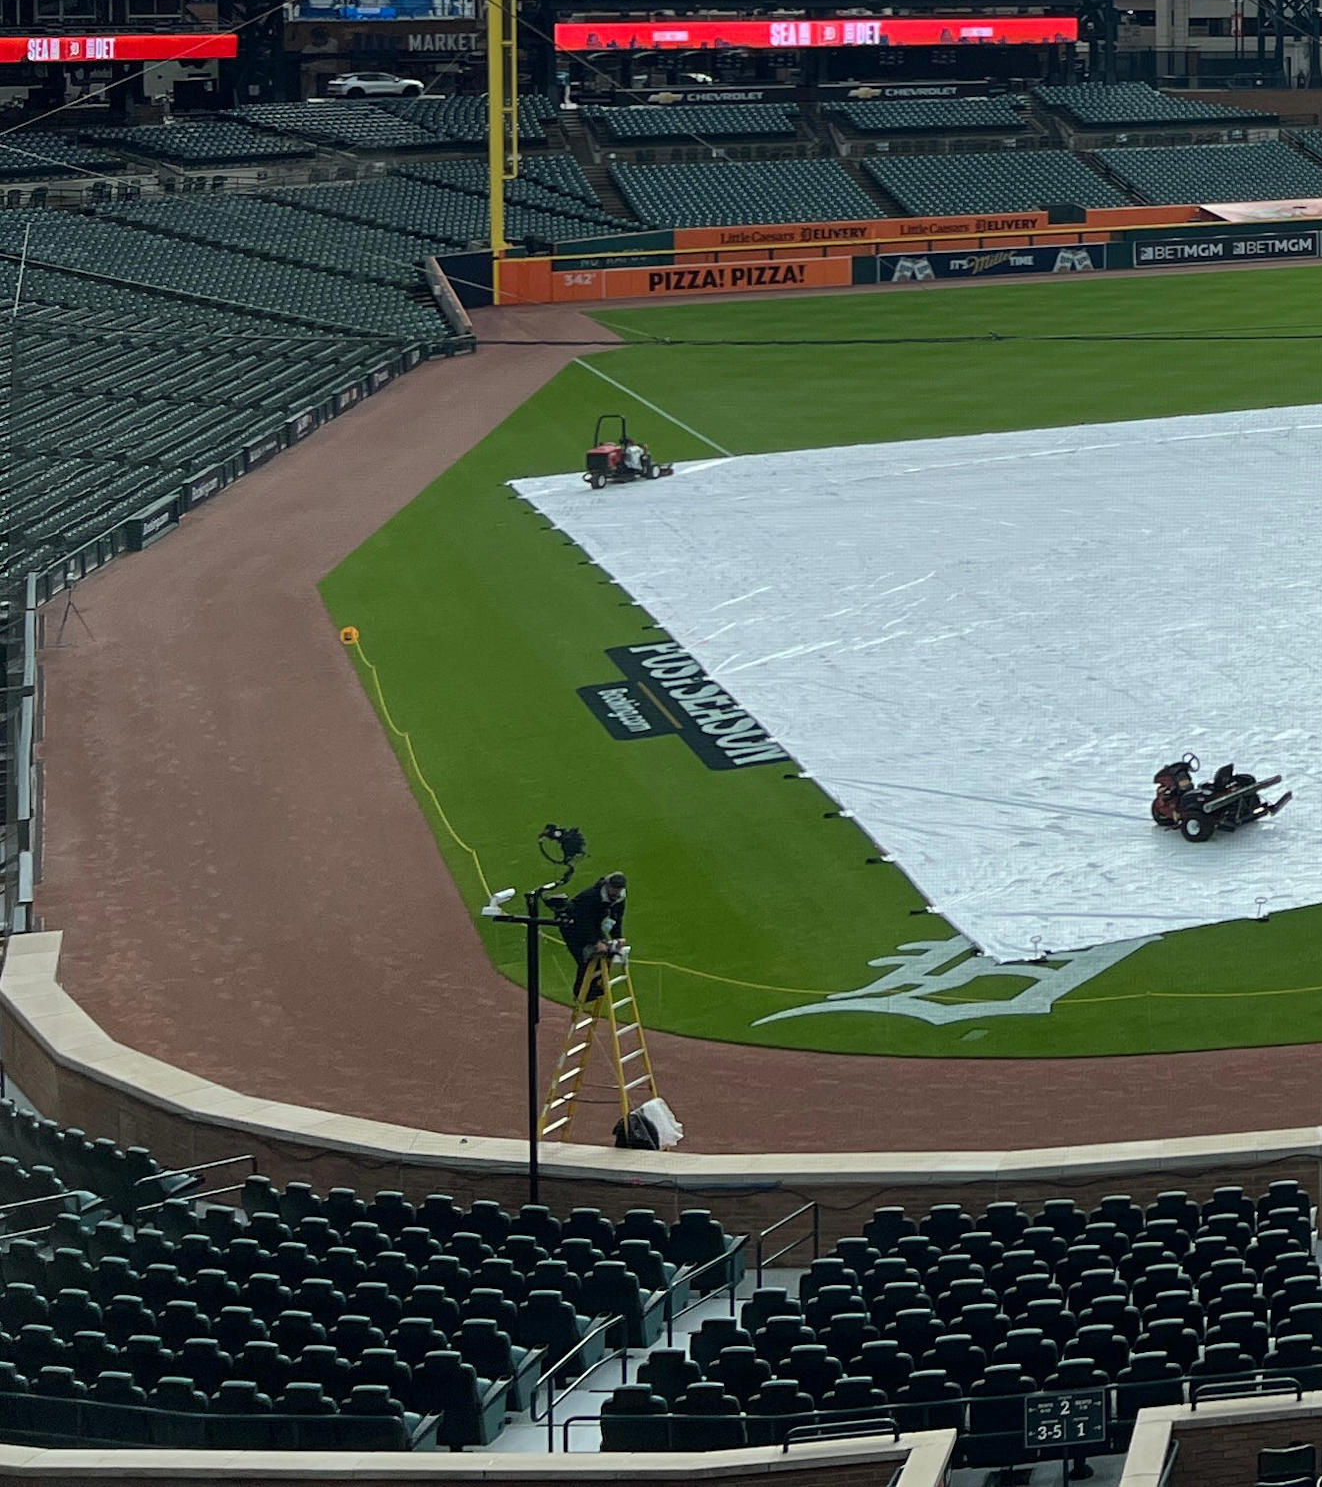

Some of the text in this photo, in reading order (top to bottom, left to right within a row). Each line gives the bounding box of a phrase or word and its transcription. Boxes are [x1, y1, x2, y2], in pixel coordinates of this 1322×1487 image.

[408, 33, 478, 51] MARKET
[770, 23, 796, 46] SEA
[856, 22, 881, 45] DET
[27, 38, 49, 61] SEA
[95, 38, 115, 59] DET
[686, 91, 763, 102] CHEVROLET
[885, 87, 957, 97] CHEVROLET
[900, 222, 929, 235] Little
[720, 232, 749, 245] Little
[1245, 237, 1312, 254] BETMGM
[1154, 241, 1223, 260] BETMGM
[650, 265, 806, 291] PIZZA! PIZZA!
[1060, 1401, 1070, 1415] 2
[1037, 1422, 1086, 1440] 3-5 1
